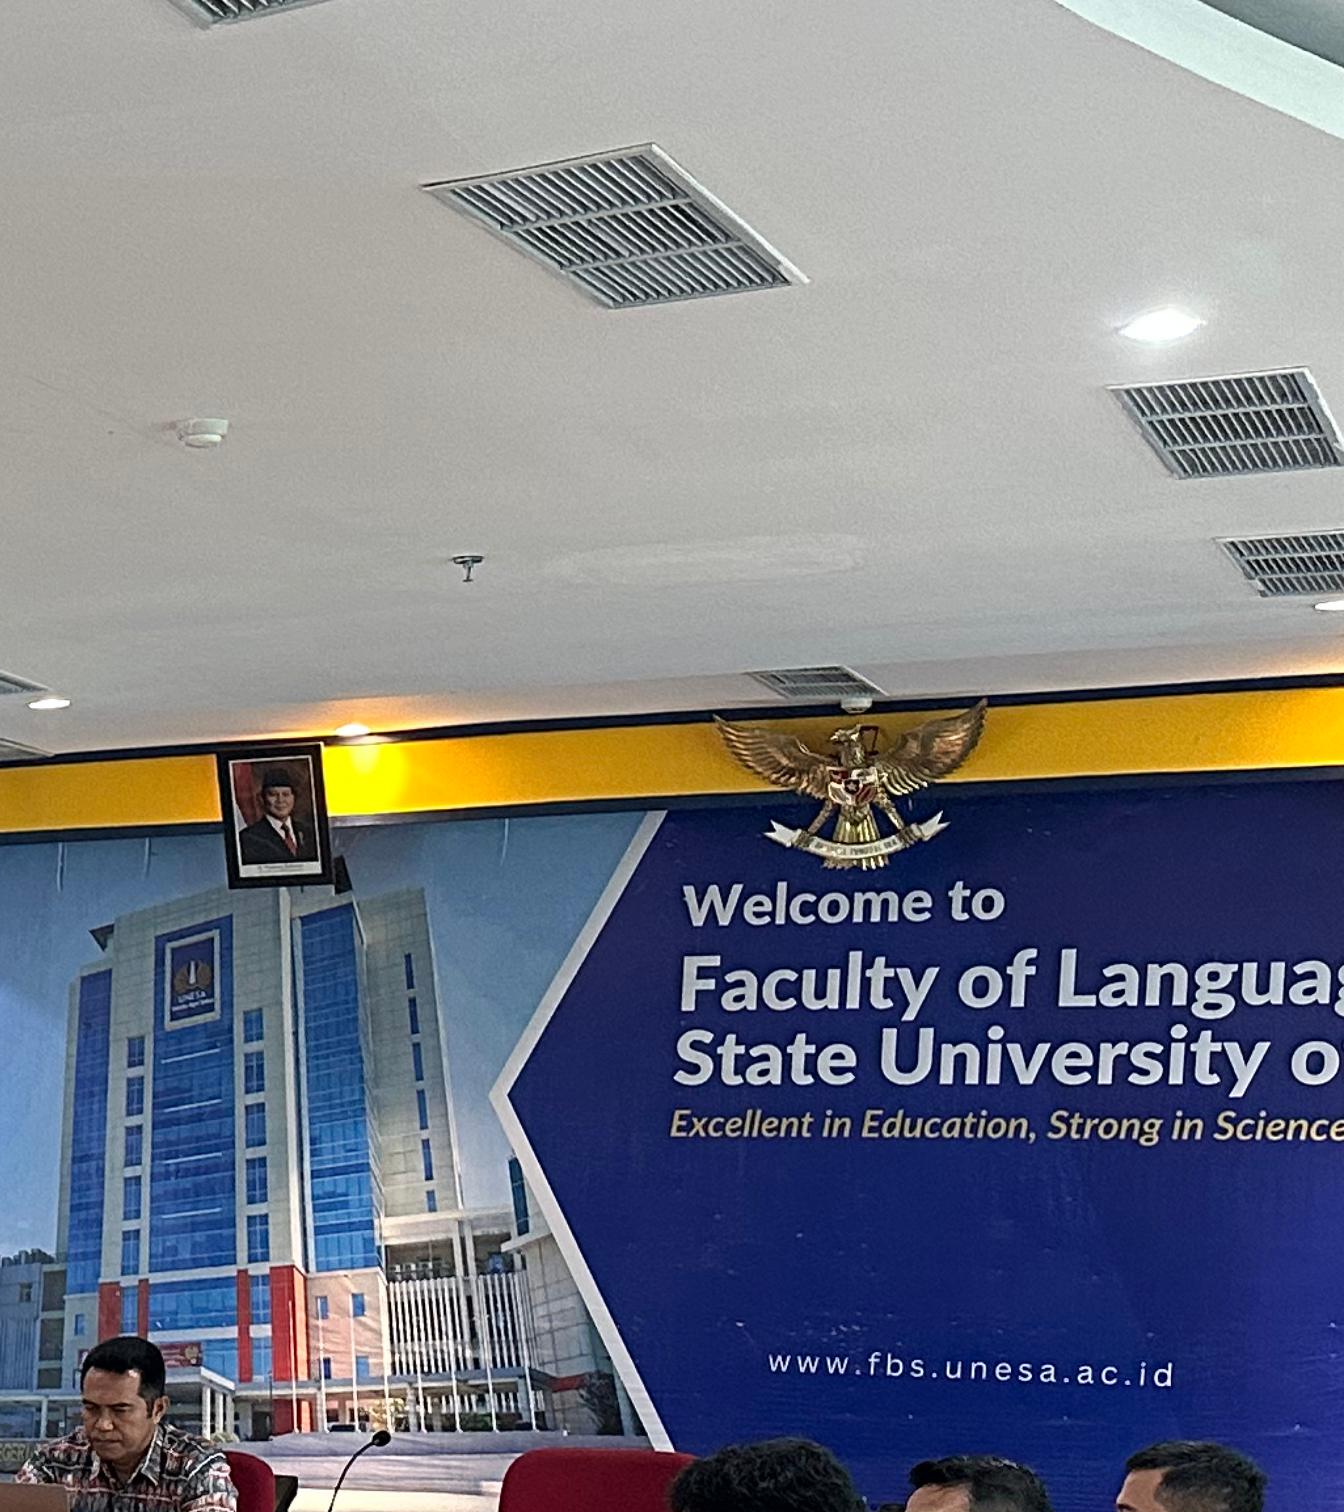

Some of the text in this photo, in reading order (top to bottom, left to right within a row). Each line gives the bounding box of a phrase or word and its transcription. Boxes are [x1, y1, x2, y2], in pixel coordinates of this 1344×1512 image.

[681, 880, 1005, 927] Welcome to
[680, 947, 1344, 1022] Faculty of Langua
[673, 1029, 857, 1086] State
[880, 1023, 1272, 1098] University
[670, 1107, 814, 1138] Excellent
[822, 1105, 851, 1138] in
[861, 1106, 1037, 1144] Education,
[1046, 1109, 1164, 1147] Strong
[1171, 1109, 1204, 1140] in
[768, 1351, 1173, 1387] www.fbs.unesa.ac.id
